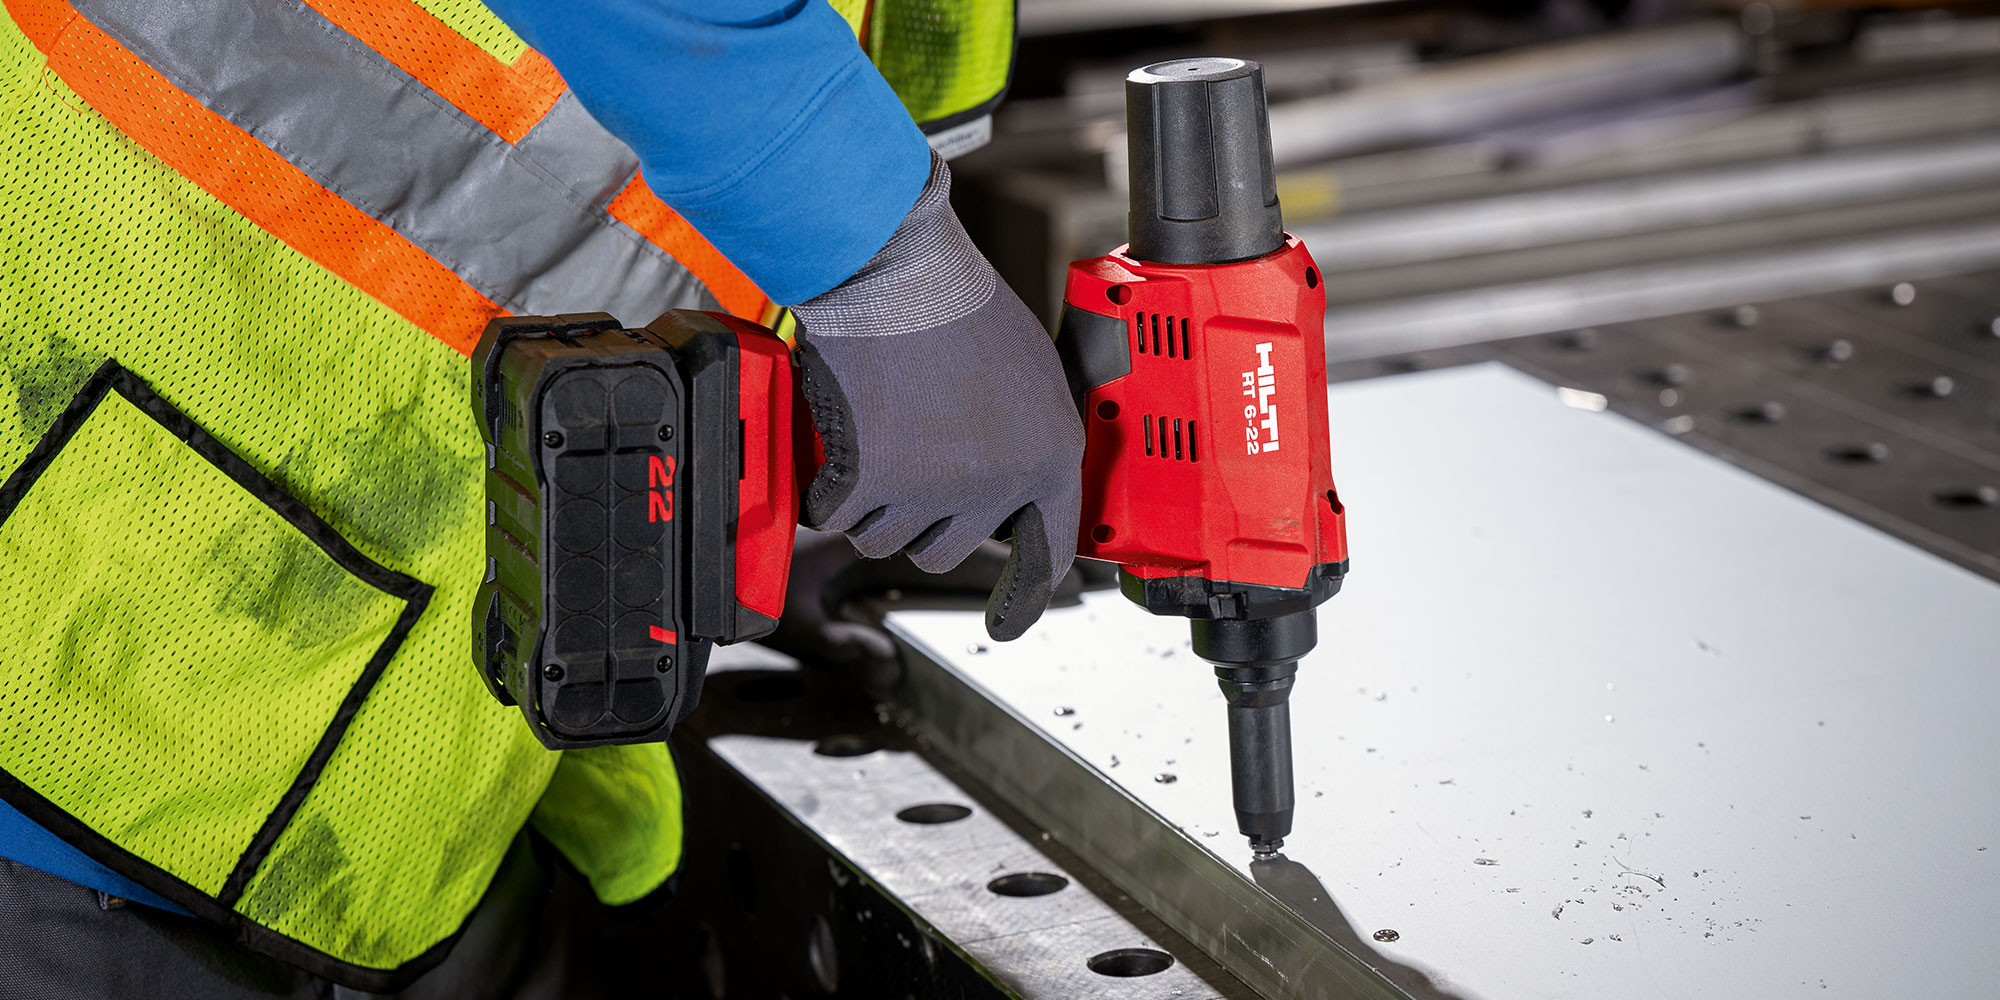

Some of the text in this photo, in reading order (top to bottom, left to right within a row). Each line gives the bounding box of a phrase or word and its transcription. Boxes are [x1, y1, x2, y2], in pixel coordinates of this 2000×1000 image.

[1242, 371, 1260, 456] RT 6-22
[1256, 342, 1280, 453] HILTI
[648, 455, 677, 523] 22
